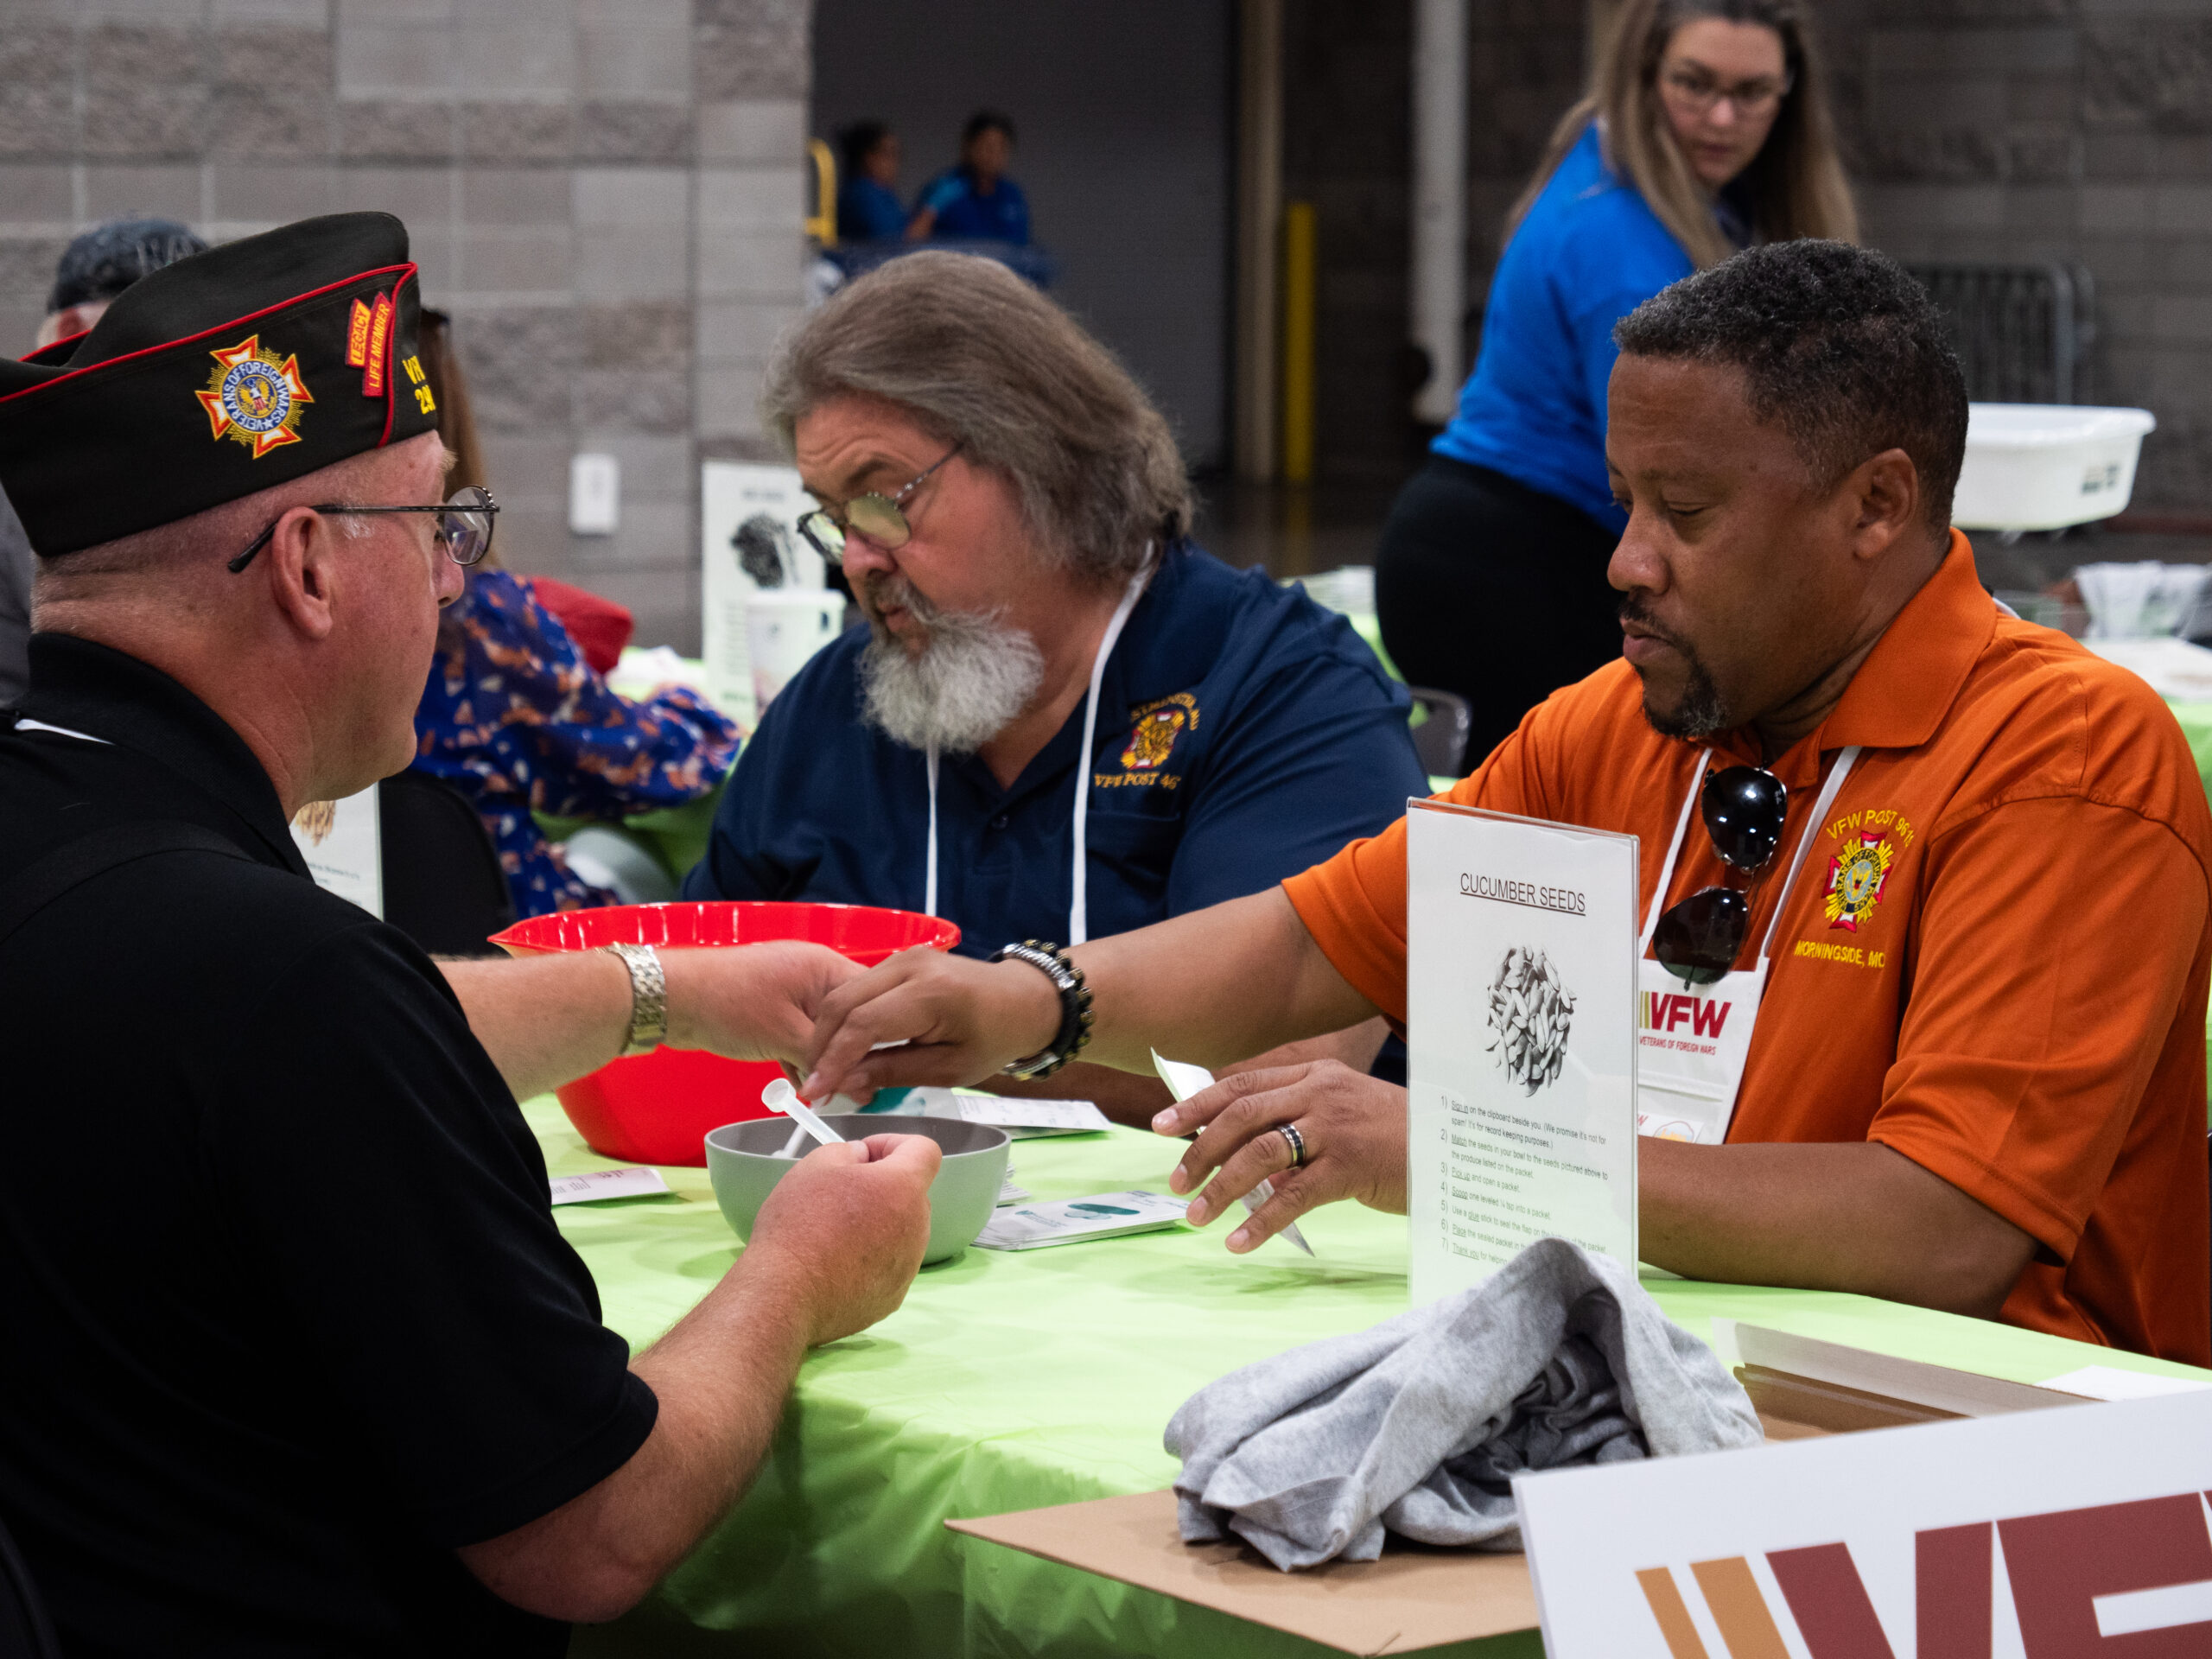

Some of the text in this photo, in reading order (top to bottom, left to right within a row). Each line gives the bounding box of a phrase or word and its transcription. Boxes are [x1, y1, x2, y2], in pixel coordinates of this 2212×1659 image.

[350, 302, 372, 365] LEGACY
[369, 303, 391, 388] LIFE MEMBER
[239, 361, 283, 388] FOREIGN
[223, 384, 264, 431] VETERANS
[270, 387, 290, 424] WARS
[1123, 772, 1160, 786] POST
[1826, 811, 1862, 840] VFW
[1865, 809, 1897, 826] POST
[1460, 873, 1586, 913] CUCUMBER SEEDS
[1795, 939, 1865, 968] MORNINGSIDE,
[1651, 991, 1732, 1039] VFW
[1639, 1036, 1717, 1056] VETERANS OF FOREIGN WARS
[1440, 1095, 1448, 1110] 1)
[1478, 1107, 1486, 1117] the
[1487, 1109, 1511, 1122] clipboard
[1512, 1116, 1529, 1128] beside
[1555, 1127, 1579, 1139] promise
[1485, 1126, 1502, 1137] record
[1503, 1128, 1523, 1143] keeping
[1440, 1128, 1448, 1143] 2)
[1478, 1141, 1493, 1153] seeds
[1500, 1148, 1512, 1158] your
[1513, 1150, 1526, 1160] bowl
[1543, 1158, 1560, 1169] seeds
[1560, 1161, 1583, 1174] pictured
[1584, 1166, 1601, 1179] above
[1461, 1154, 1482, 1166] produce
[1440, 1161, 1448, 1176] 3)
[1440, 1181, 1448, 1196] 4)
[1440, 1199, 1448, 1214] 5)
[1440, 1218, 1449, 1233] 6)
